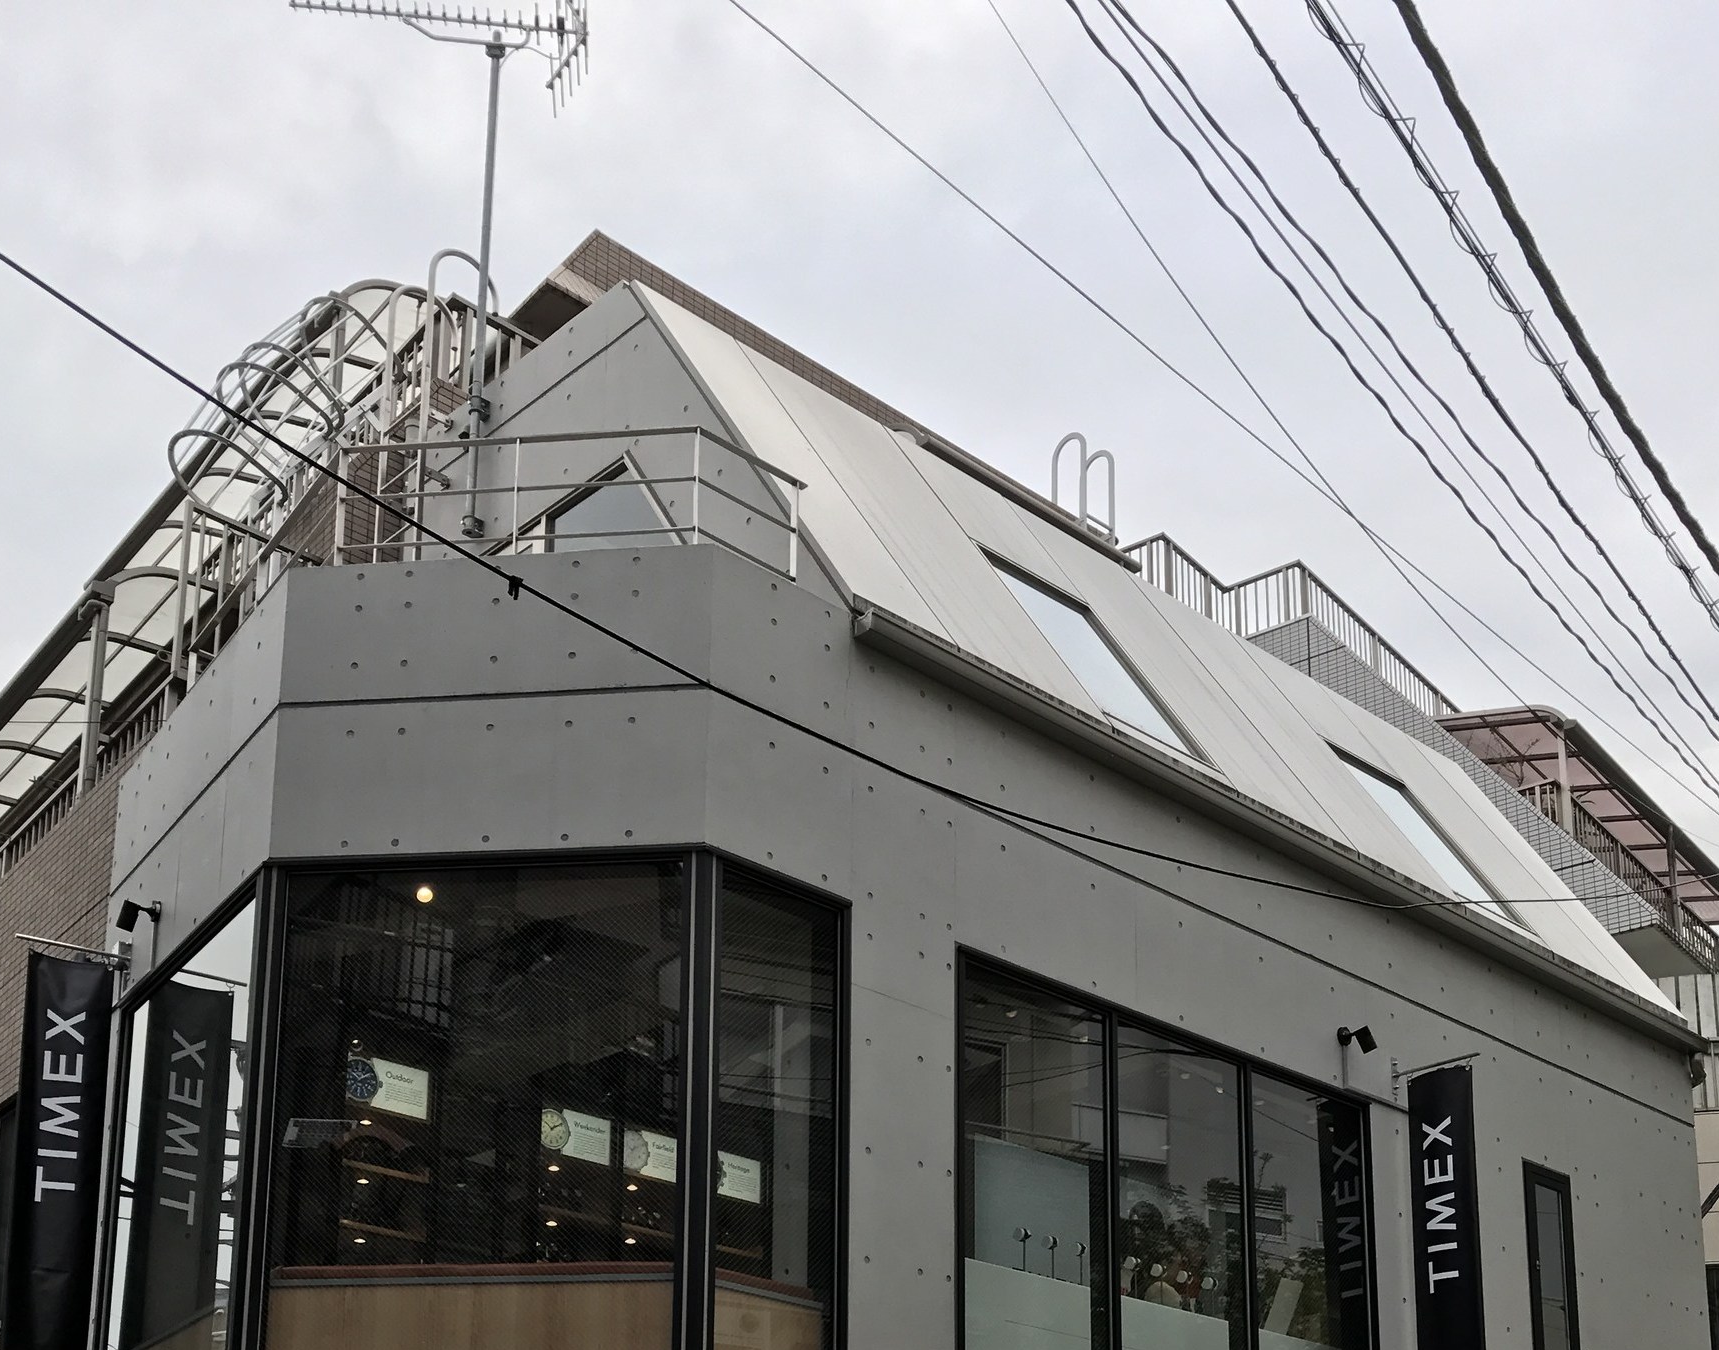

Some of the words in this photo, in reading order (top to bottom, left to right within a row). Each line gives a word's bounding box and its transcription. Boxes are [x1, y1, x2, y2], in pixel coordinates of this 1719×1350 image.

[34, 1006, 87, 1203] TIMEX
[385, 1070, 414, 1084] Outdoor
[1421, 1115, 1460, 1294] TIMEX
